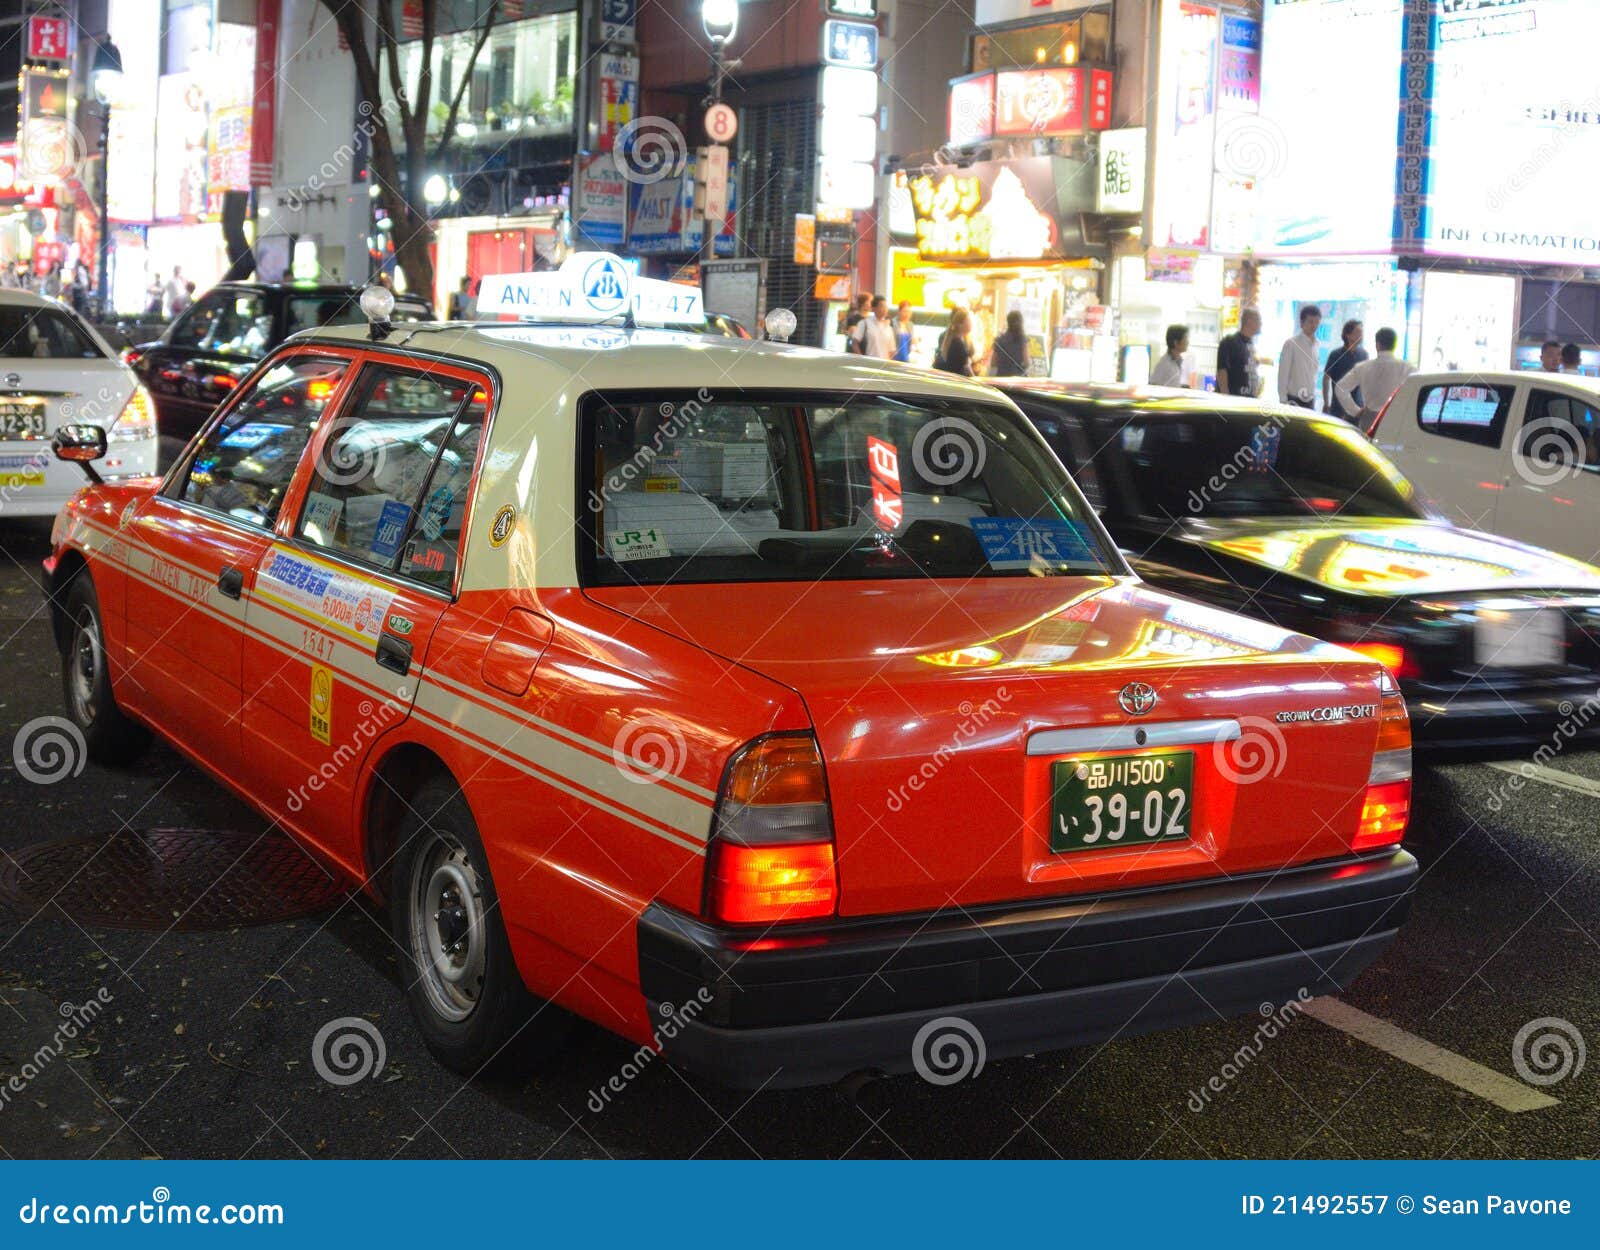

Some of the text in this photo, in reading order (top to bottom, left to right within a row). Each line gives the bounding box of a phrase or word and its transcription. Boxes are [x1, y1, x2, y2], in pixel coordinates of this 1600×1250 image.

[713, 111, 728, 134] 8
[1104, 149, 1132, 196] 鮨
[1441, 226, 1600, 252] INFORMATIO
[501, 284, 697, 315] ANN 147
[615, 531, 643, 545] JR
[150, 558, 211, 603] ANZEN TAXI
[302, 629, 335, 662] 1547
[1275, 703, 1378, 723] CROWN COMFORT
[1059, 788, 1186, 844] い 39-02
